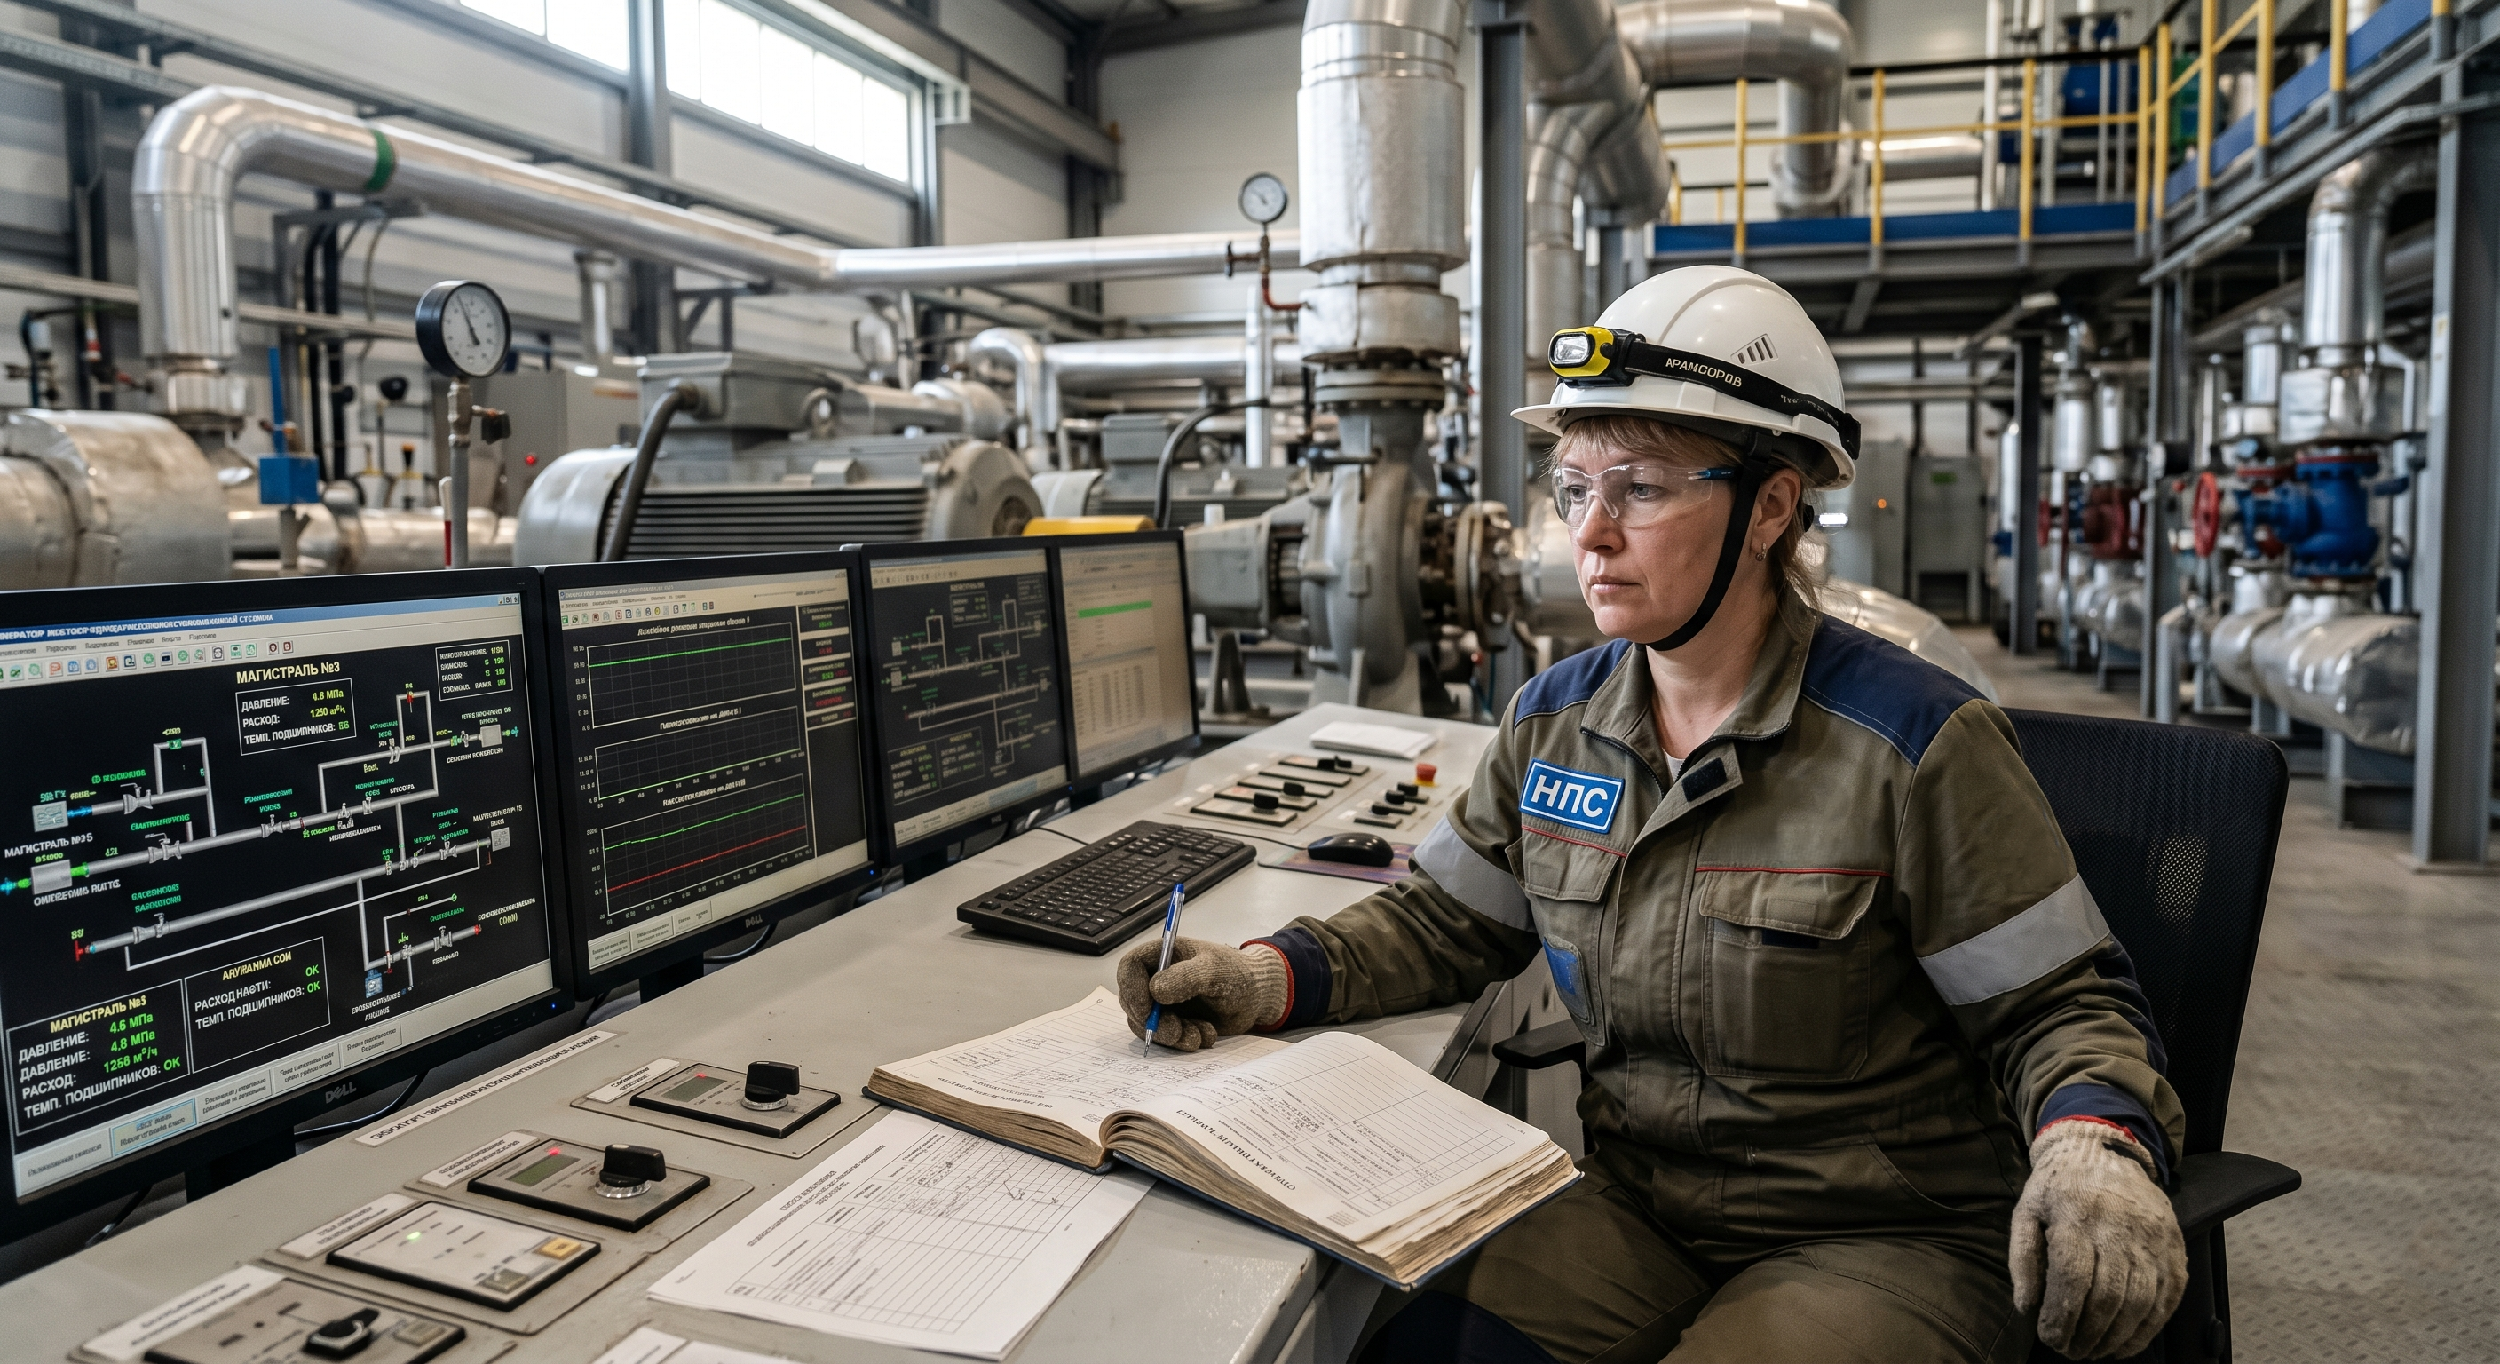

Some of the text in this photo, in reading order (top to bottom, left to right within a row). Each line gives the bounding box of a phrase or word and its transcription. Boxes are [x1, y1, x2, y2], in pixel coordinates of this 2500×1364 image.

[236, 661, 341, 684] МАГИСТРАЛЬ №3
[241, 696, 290, 713] ДАВЛЕНИЕ:
[326, 689, 345, 699] МПа
[242, 715, 281, 728] РАСХОД:
[244, 733, 271, 745] ТЕМП.
[1530, 774, 1609, 818] НПС
[3, 838, 70, 859] МАГИСТРАЛЬ
[194, 991, 236, 1012] РАСХОД
[227, 986, 305, 1020] ПОДШИПНИКОВ:
[50, 1002, 127, 1034] МАГИСТРАЛЬ
[18, 1012, 154, 1065] ДАВЛЕНИЕ: 4.6 МПа
[19, 1030, 155, 1083] ДАВЛЕНИЕ: 4.8 МПа
[22, 1073, 77, 1100] РАСХОД:
[24, 1098, 62, 1119] ТЕМП.
[65, 1065, 162, 1106] ПОДШИПНИКОВ:
[325, 1081, 357, 1105] DELL
